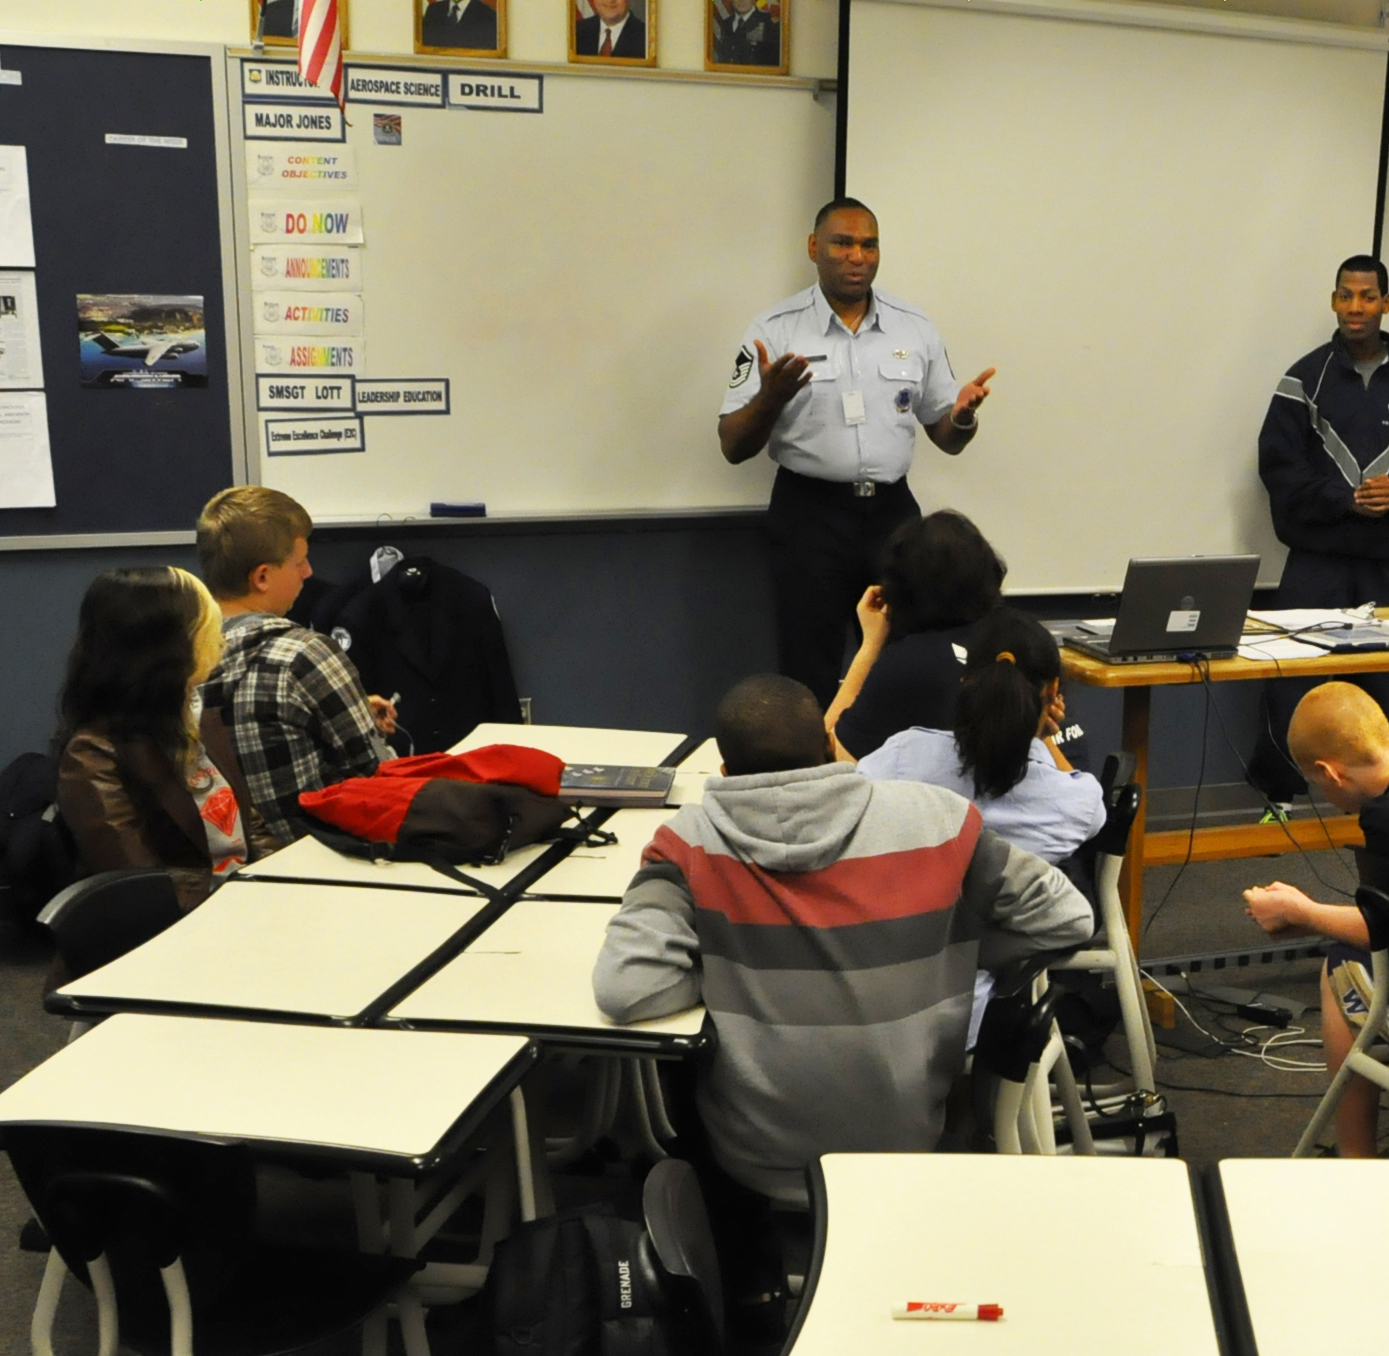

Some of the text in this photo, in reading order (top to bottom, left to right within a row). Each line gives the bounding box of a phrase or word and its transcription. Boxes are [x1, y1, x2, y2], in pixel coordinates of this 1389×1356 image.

[350, 78, 441, 98] AEROSPACE SCIENCE
[460, 83, 521, 99] DRILL
[255, 112, 332, 130] MAJOR JONES
[287, 156, 338, 166] CONTENT
[281, 169, 347, 179] OBJECTIVES
[285, 213, 349, 234] DO NOW
[285, 258, 349, 279] ANNOUNCEMENTS
[285, 306, 349, 323] ACTIVITIES
[290, 346, 354, 367] ASSIGNMENTS
[268, 385, 342, 400] SMSGT LOTT
[358, 390, 442, 404] LEADERSHIP EDUCATION
[618, 1260, 632, 1308] GRENADE
